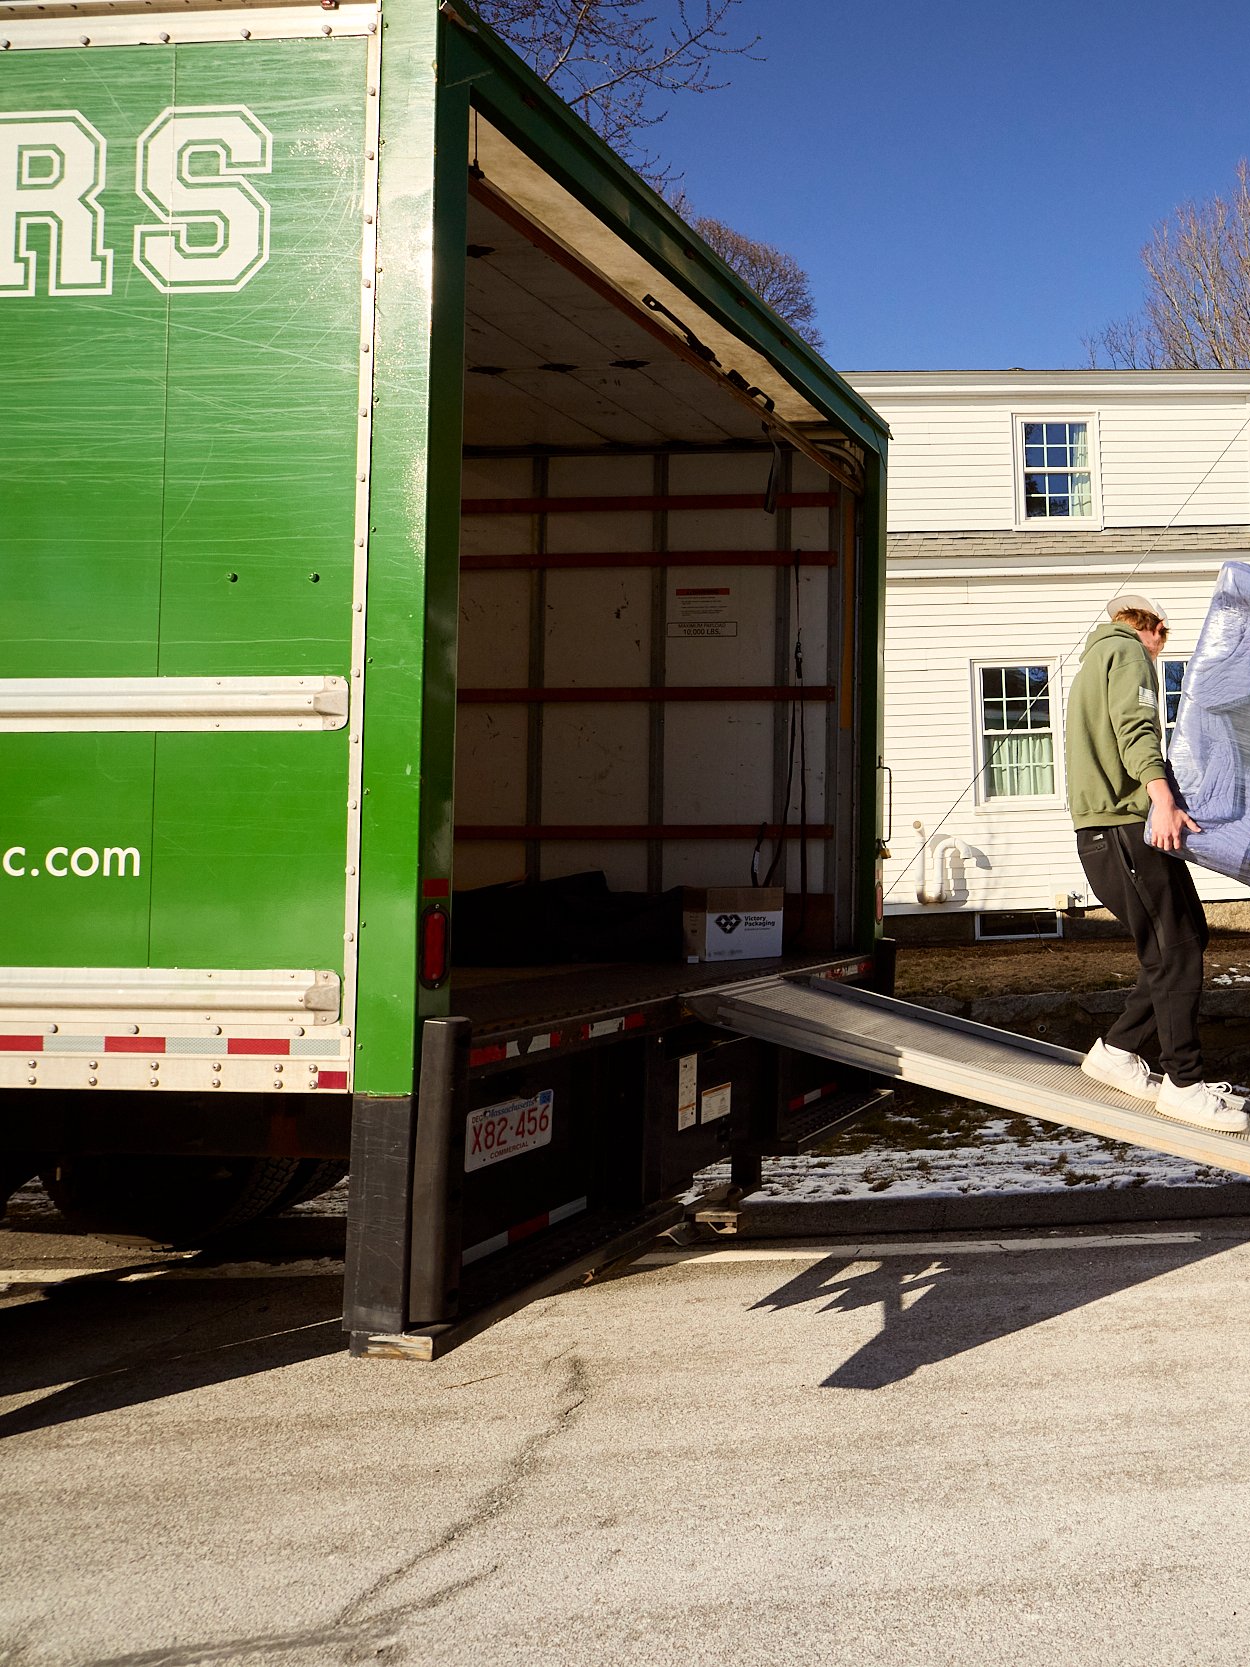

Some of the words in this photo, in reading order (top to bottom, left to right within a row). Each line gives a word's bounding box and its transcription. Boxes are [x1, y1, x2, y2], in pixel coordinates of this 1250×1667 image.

[683, 628, 705, 636] 10,000
[2, 846, 140, 877] c.com
[489, 1141, 529, 1160] COMMERCIAL
